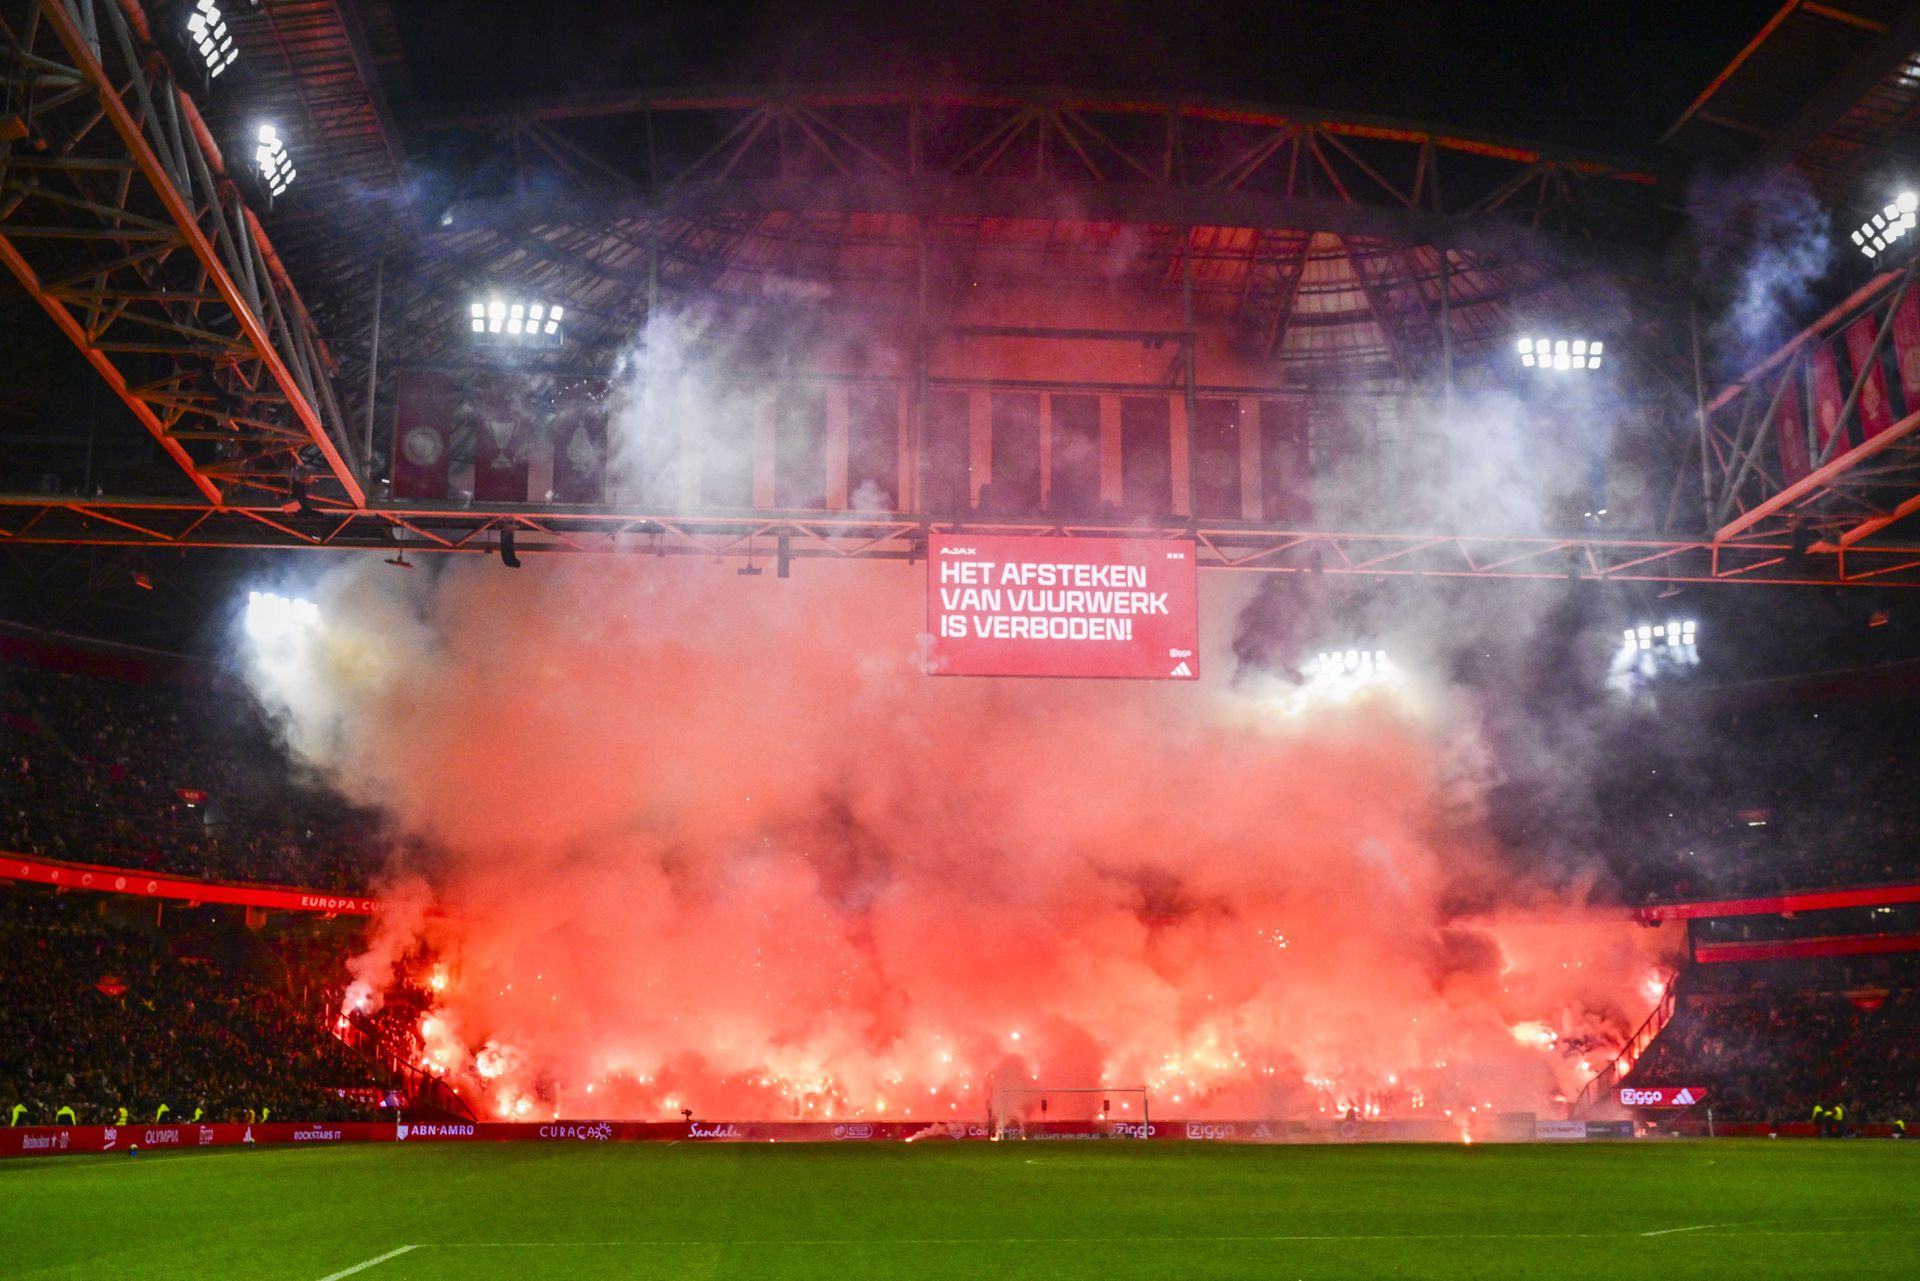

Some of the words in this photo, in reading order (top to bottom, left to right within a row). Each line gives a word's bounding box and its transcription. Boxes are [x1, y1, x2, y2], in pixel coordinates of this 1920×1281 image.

[940, 547, 976, 555] AJAX
[941, 562, 995, 584] HET
[1001, 564, 1146, 588] AFSTEKEN
[940, 588, 1000, 611] VAN
[1007, 589, 1168, 615] VUURWERK
[941, 615, 967, 638] IS
[973, 616, 1132, 641] VERBODEN!
[301, 896, 356, 910] EUROPA
[361, 901, 386, 911] CU
[145, 1130, 178, 1144] OLYMPIA
[293, 1131, 334, 1140] ROCKSTARS
[688, 1122, 737, 1139] Sandals
[1186, 1121, 1234, 1140] Ziggo
